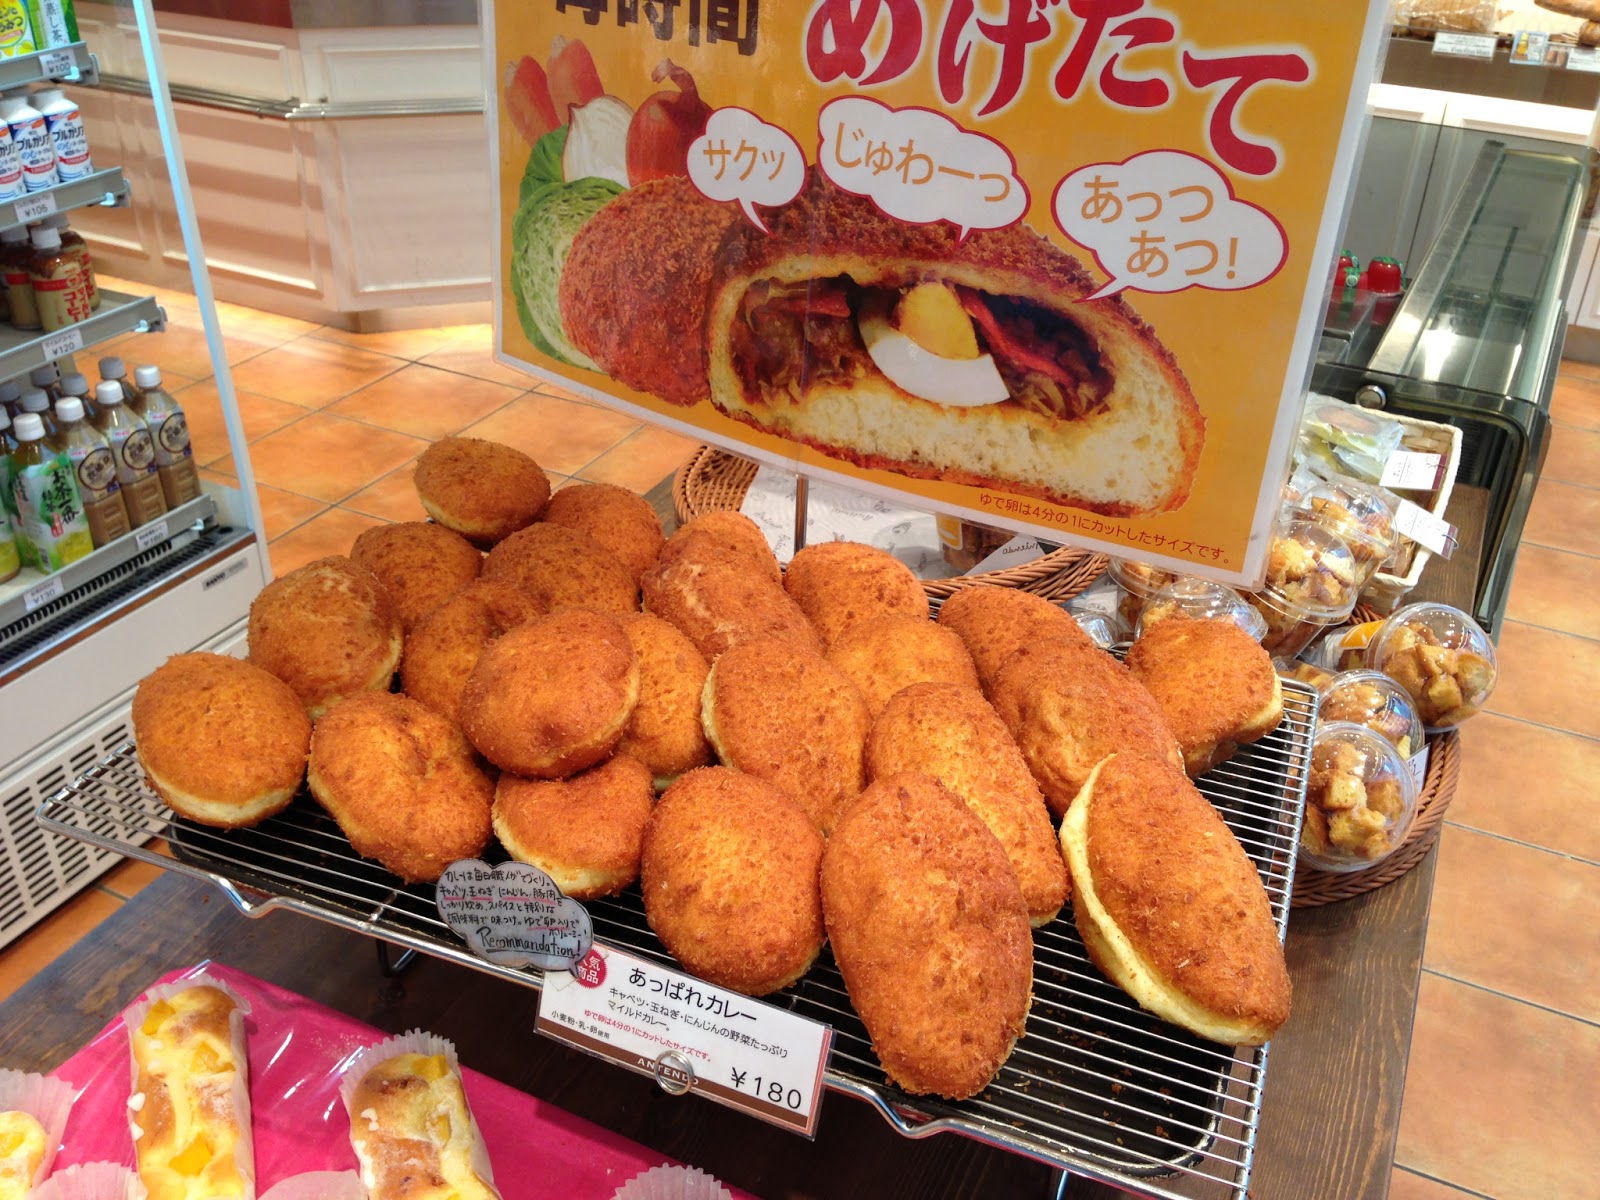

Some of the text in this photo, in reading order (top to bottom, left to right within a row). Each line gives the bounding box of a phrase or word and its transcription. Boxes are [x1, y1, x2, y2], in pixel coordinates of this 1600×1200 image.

[703, 138, 786, 182] サクッ
[833, 121, 1011, 204] じゅわーっ
[24, 203, 49, 218] ¥105
[1080, 174, 1214, 223] あっつ
[1126, 230, 1239, 279] あつ!
[52, 341, 75, 355] ¥120
[980, 493, 1229, 564] ゆで卵は4分の1にカットしたサイズです。
[608, 1000, 670, 1031] マイルドカレー。
[629, 967, 757, 1021] あっぱれカレー
[585, 1009, 711, 1062] ゆで卵は4分の1にカットしたサイズです。
[609, 987, 788, 1058] キャベツ・玉ねぎ・にんじんの野菜たっぷり
[731, 1067, 802, 1109] ¥180
